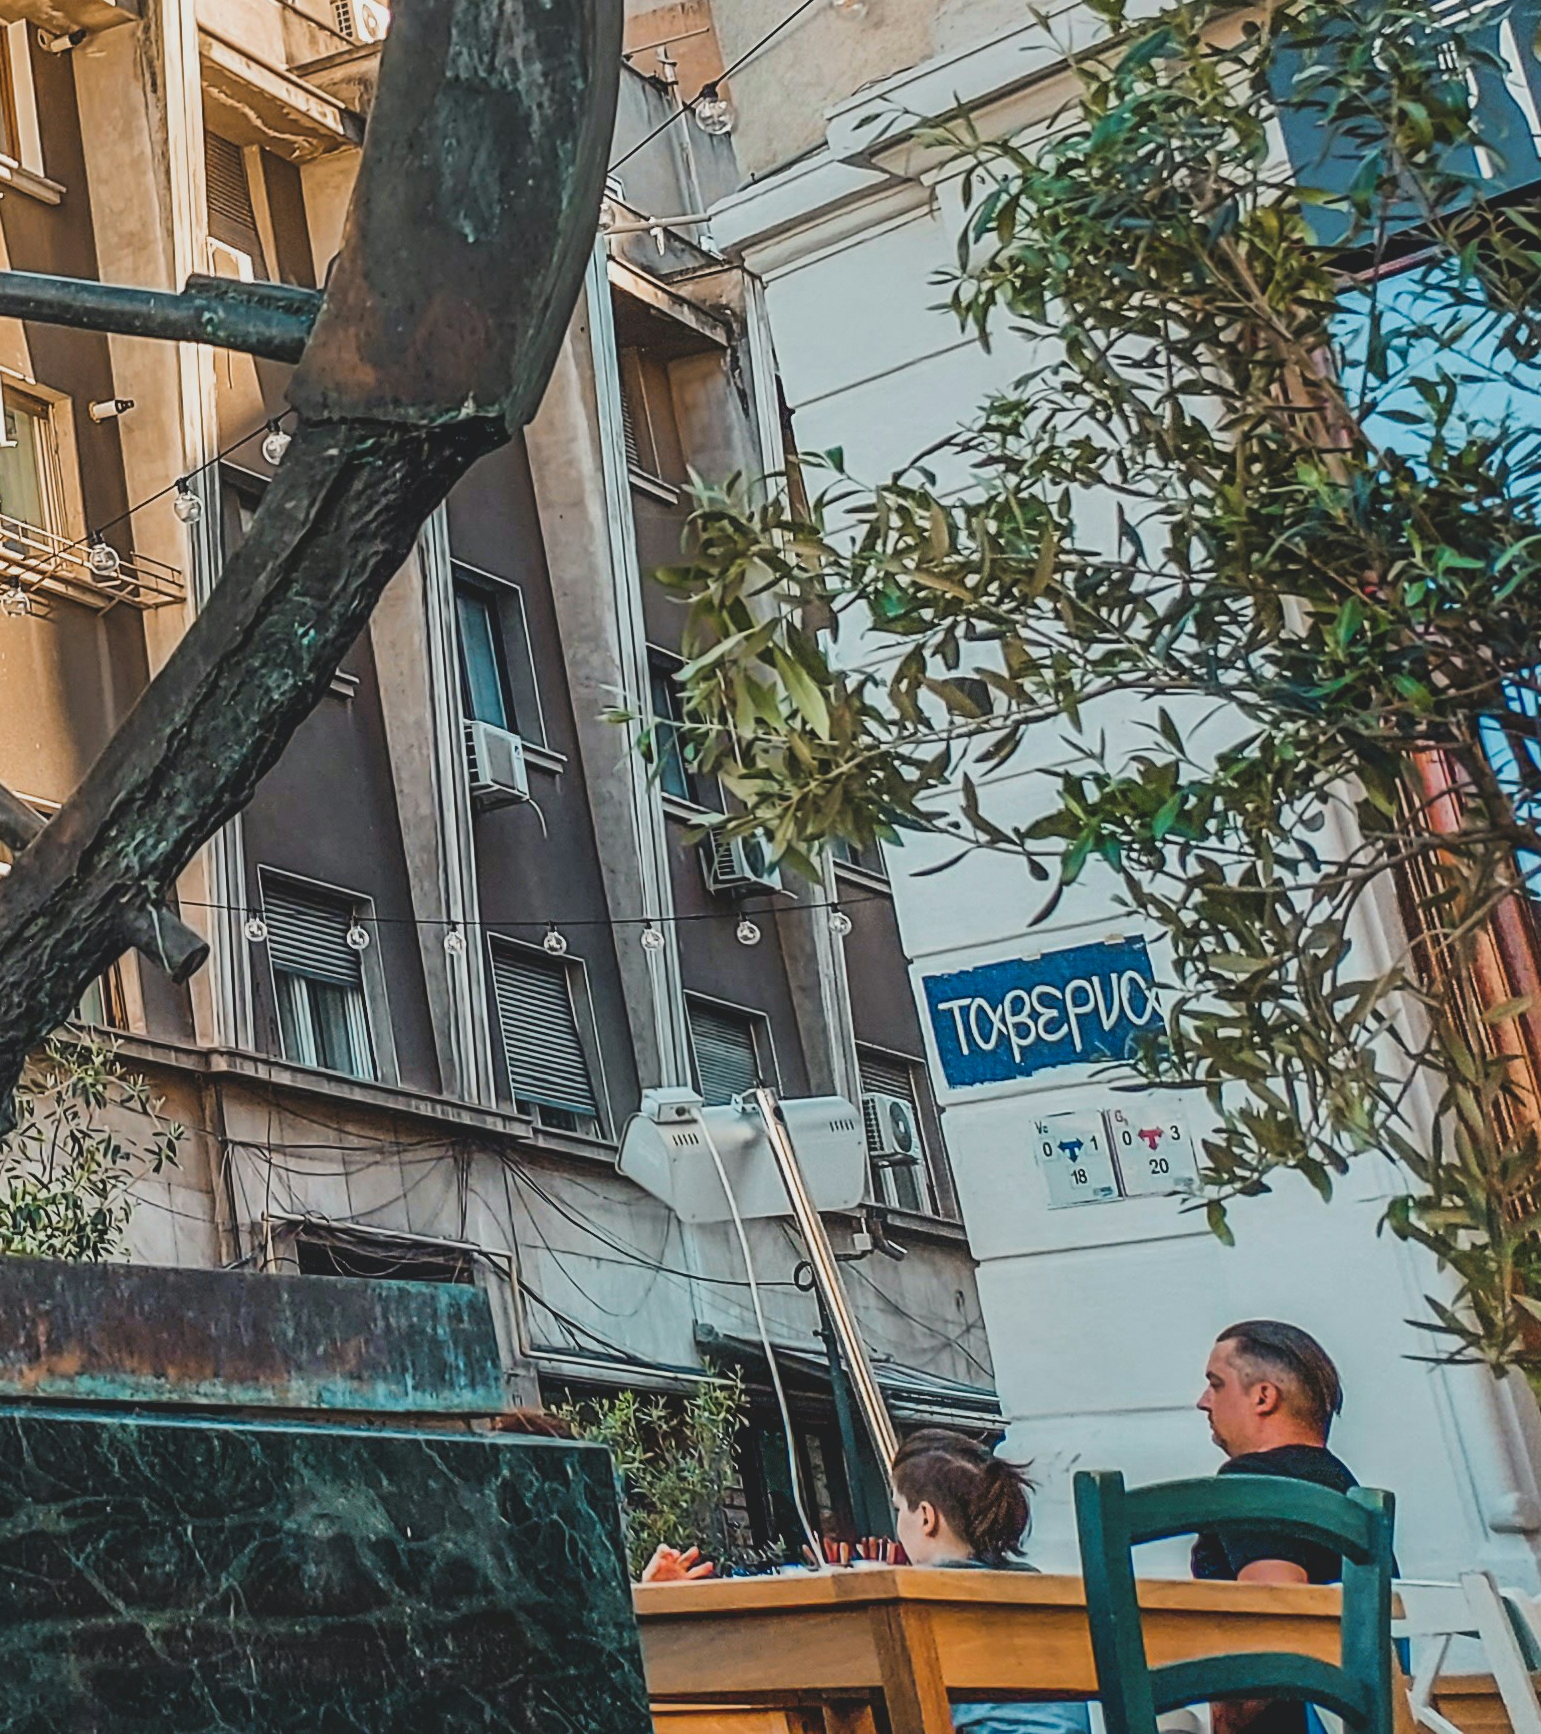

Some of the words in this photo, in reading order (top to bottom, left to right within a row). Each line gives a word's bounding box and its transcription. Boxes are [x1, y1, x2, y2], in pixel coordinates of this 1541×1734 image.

[1122, 1130, 1132, 1146] 0
[1169, 1125, 1181, 1141] 3
[1042, 1141, 1053, 1157] 0
[1090, 1135, 1099, 1151] 1
[1149, 1157, 1170, 1175] 20
[1070, 1168, 1089, 1185] 18
